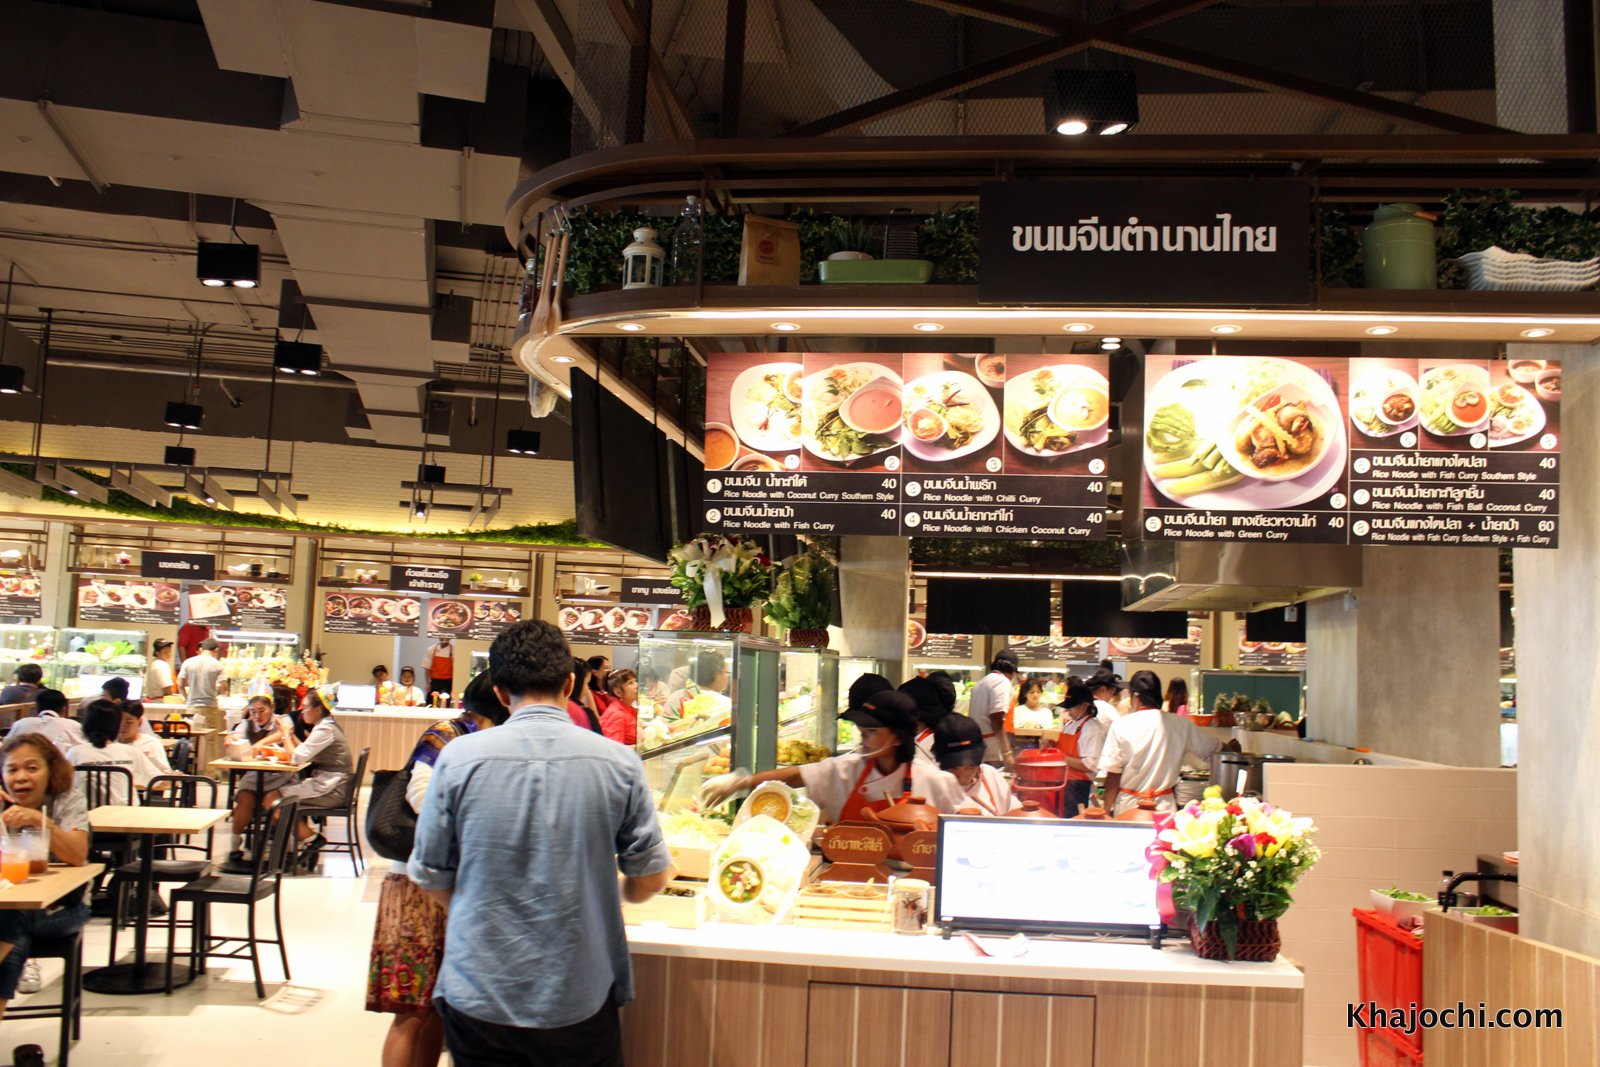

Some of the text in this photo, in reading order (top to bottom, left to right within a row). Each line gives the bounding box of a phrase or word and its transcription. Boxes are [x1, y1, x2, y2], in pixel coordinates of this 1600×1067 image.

[1012, 213, 1277, 252] ขนมจีนตำนานไทย
[1539, 457, 1556, 469] 40
[1372, 470, 1537, 481] Rice Noodle with Fish Curry Southern Style
[881, 478, 897, 489] 40
[1086, 481, 1103, 493] 40
[724, 490, 895, 501] Rice Noodle with Coconut Curry Southern Style
[923, 494, 1041, 504] Rice Noodle with Chilli Curry
[1538, 489, 1555, 500] 40
[1372, 502, 1547, 514] Rice Noodle with Fish Ball Coconut Curry
[880, 509, 896, 520] 40
[1086, 513, 1103, 524] 40
[743, 521, 771, 529] Noodle
[774, 521, 790, 529] with
[793, 522, 810, 530] Fish
[813, 523, 835, 532] Curry
[1328, 517, 1344, 528] 40
[1538, 520, 1555, 532] 60
[922, 524, 1091, 536] Rice Noodle with Chicken Coconut Curry
[1164, 529, 1288, 541] Rice Noodle with Green Curry
[1371, 533, 1386, 541] Rice
[1388, 533, 1410, 542] Noodle
[1412, 534, 1425, 542] with
[1427, 534, 1440, 542] Fish
[1443, 534, 1460, 544] Curry
[1462, 534, 1490, 543] Southern
[1492, 535, 1508, 544] Style
[1517, 535, 1531, 544] Fish
[1533, 536, 1551, 545] Curry
